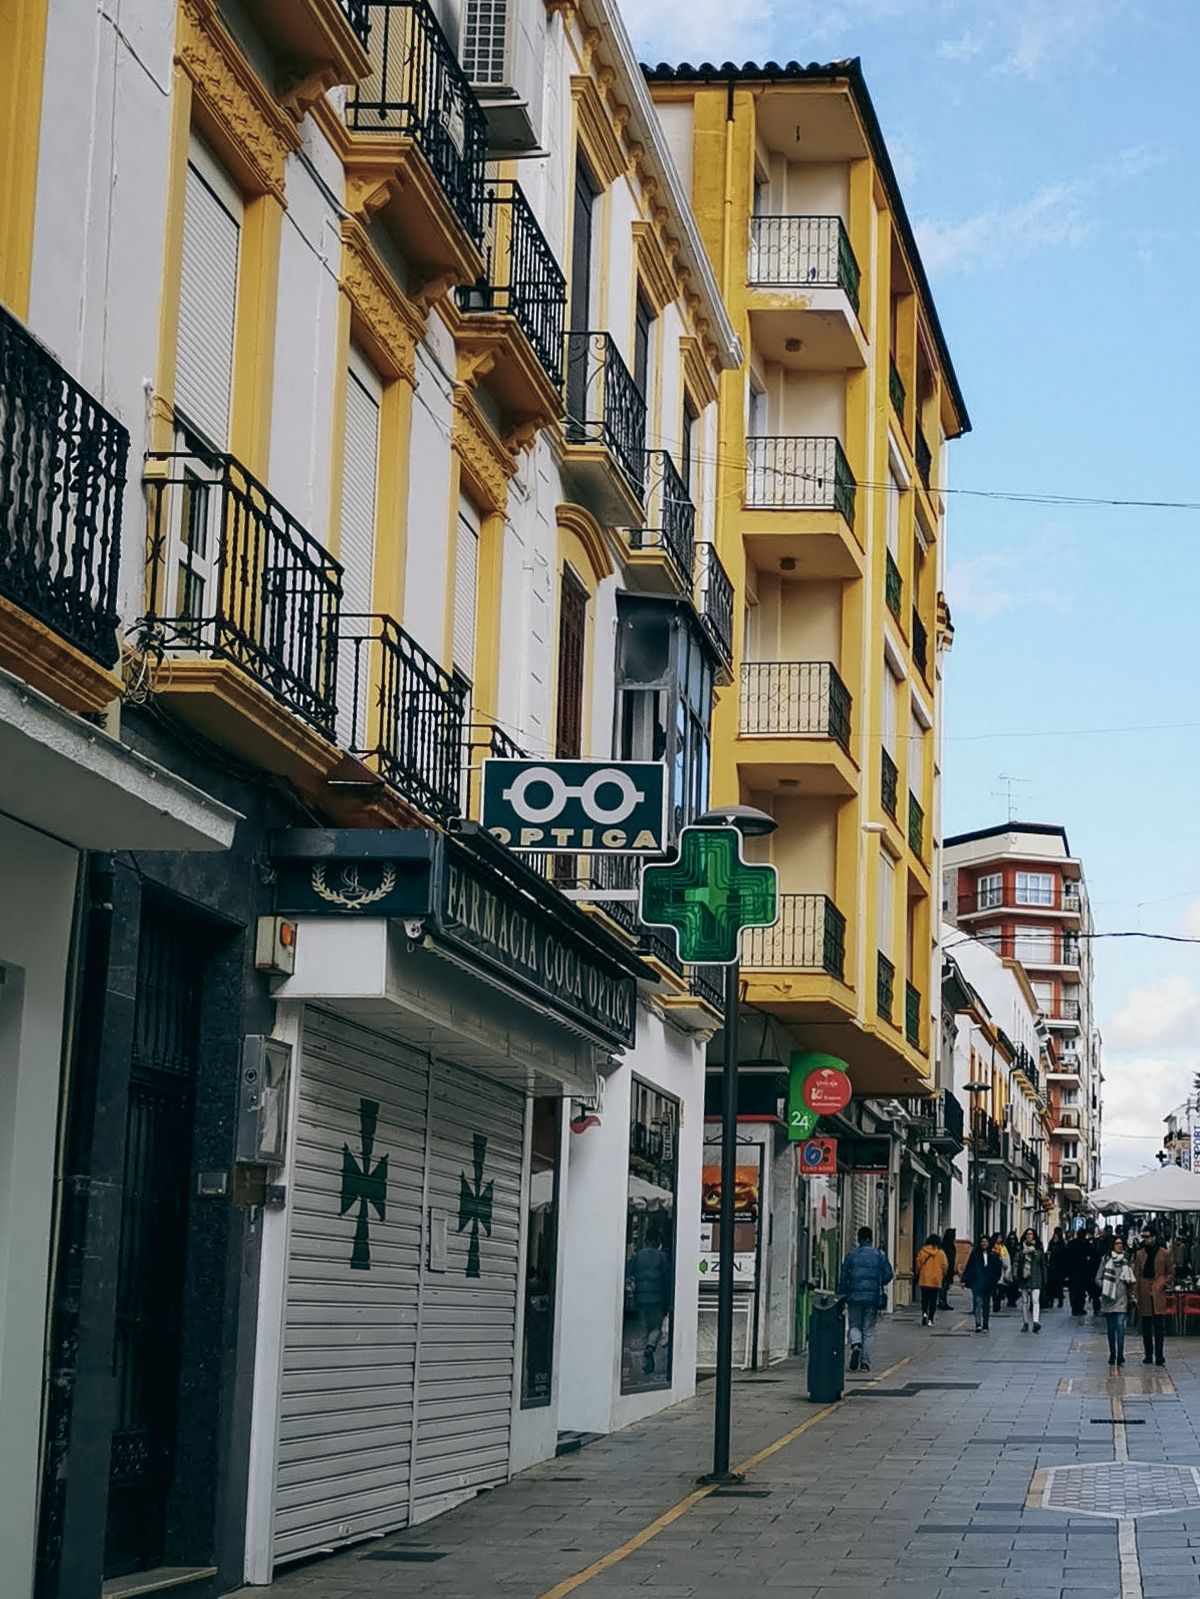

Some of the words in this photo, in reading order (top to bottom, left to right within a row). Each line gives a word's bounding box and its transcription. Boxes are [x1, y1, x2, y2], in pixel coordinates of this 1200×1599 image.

[487, 827, 659, 849] OPTICA
[447, 864, 537, 971] FARMACIA
[545, 935, 582, 999] COCA
[590, 963, 630, 1029] OPTICA
